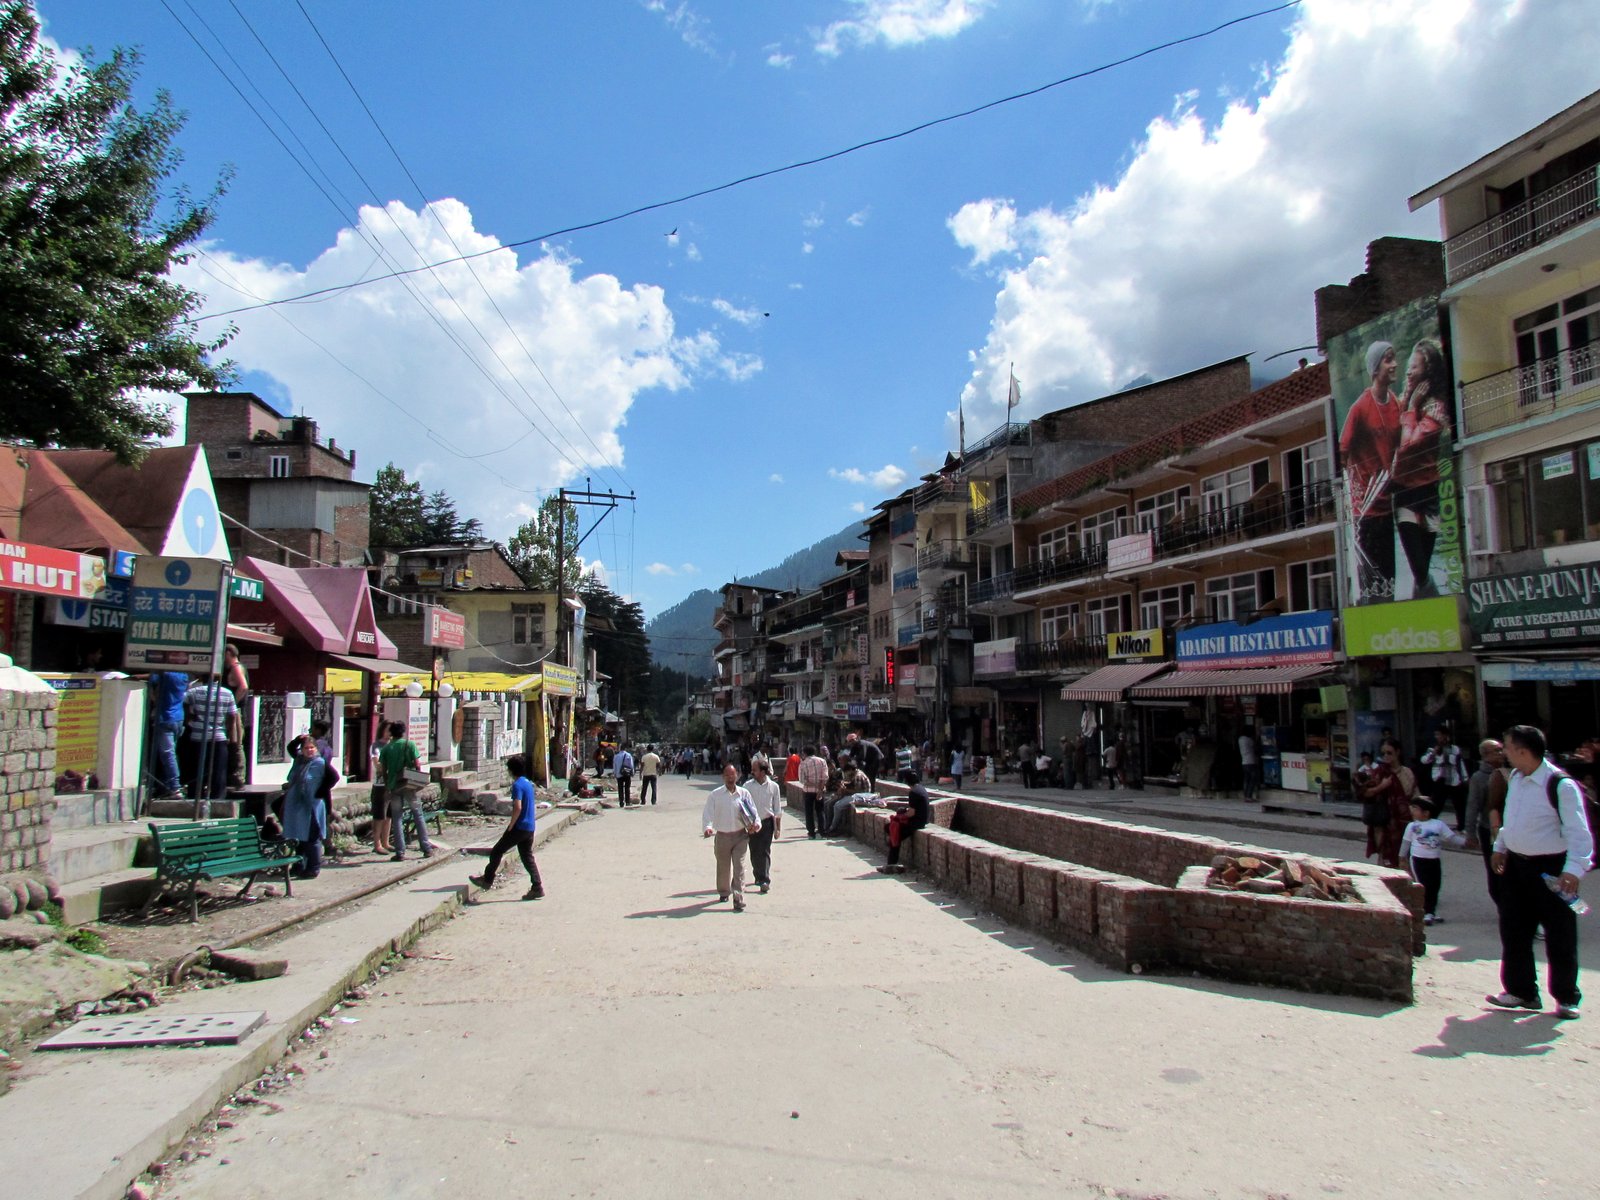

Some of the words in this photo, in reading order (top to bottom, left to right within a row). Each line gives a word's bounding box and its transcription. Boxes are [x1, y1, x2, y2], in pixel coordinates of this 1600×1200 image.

[12, 561, 77, 591] HUT
[132, 622, 159, 639] STATE
[161, 623, 189, 641] BANK
[190, 624, 210, 642] ATM
[1492, 615, 1523, 628] PURE
[1116, 634, 1151, 655] Nikon
[1178, 637, 1226, 656] ADARSH
[1229, 626, 1329, 652] RESTAURANT
[1371, 627, 1440, 651] adidas
[1316, 650, 1329, 660] FOOD
